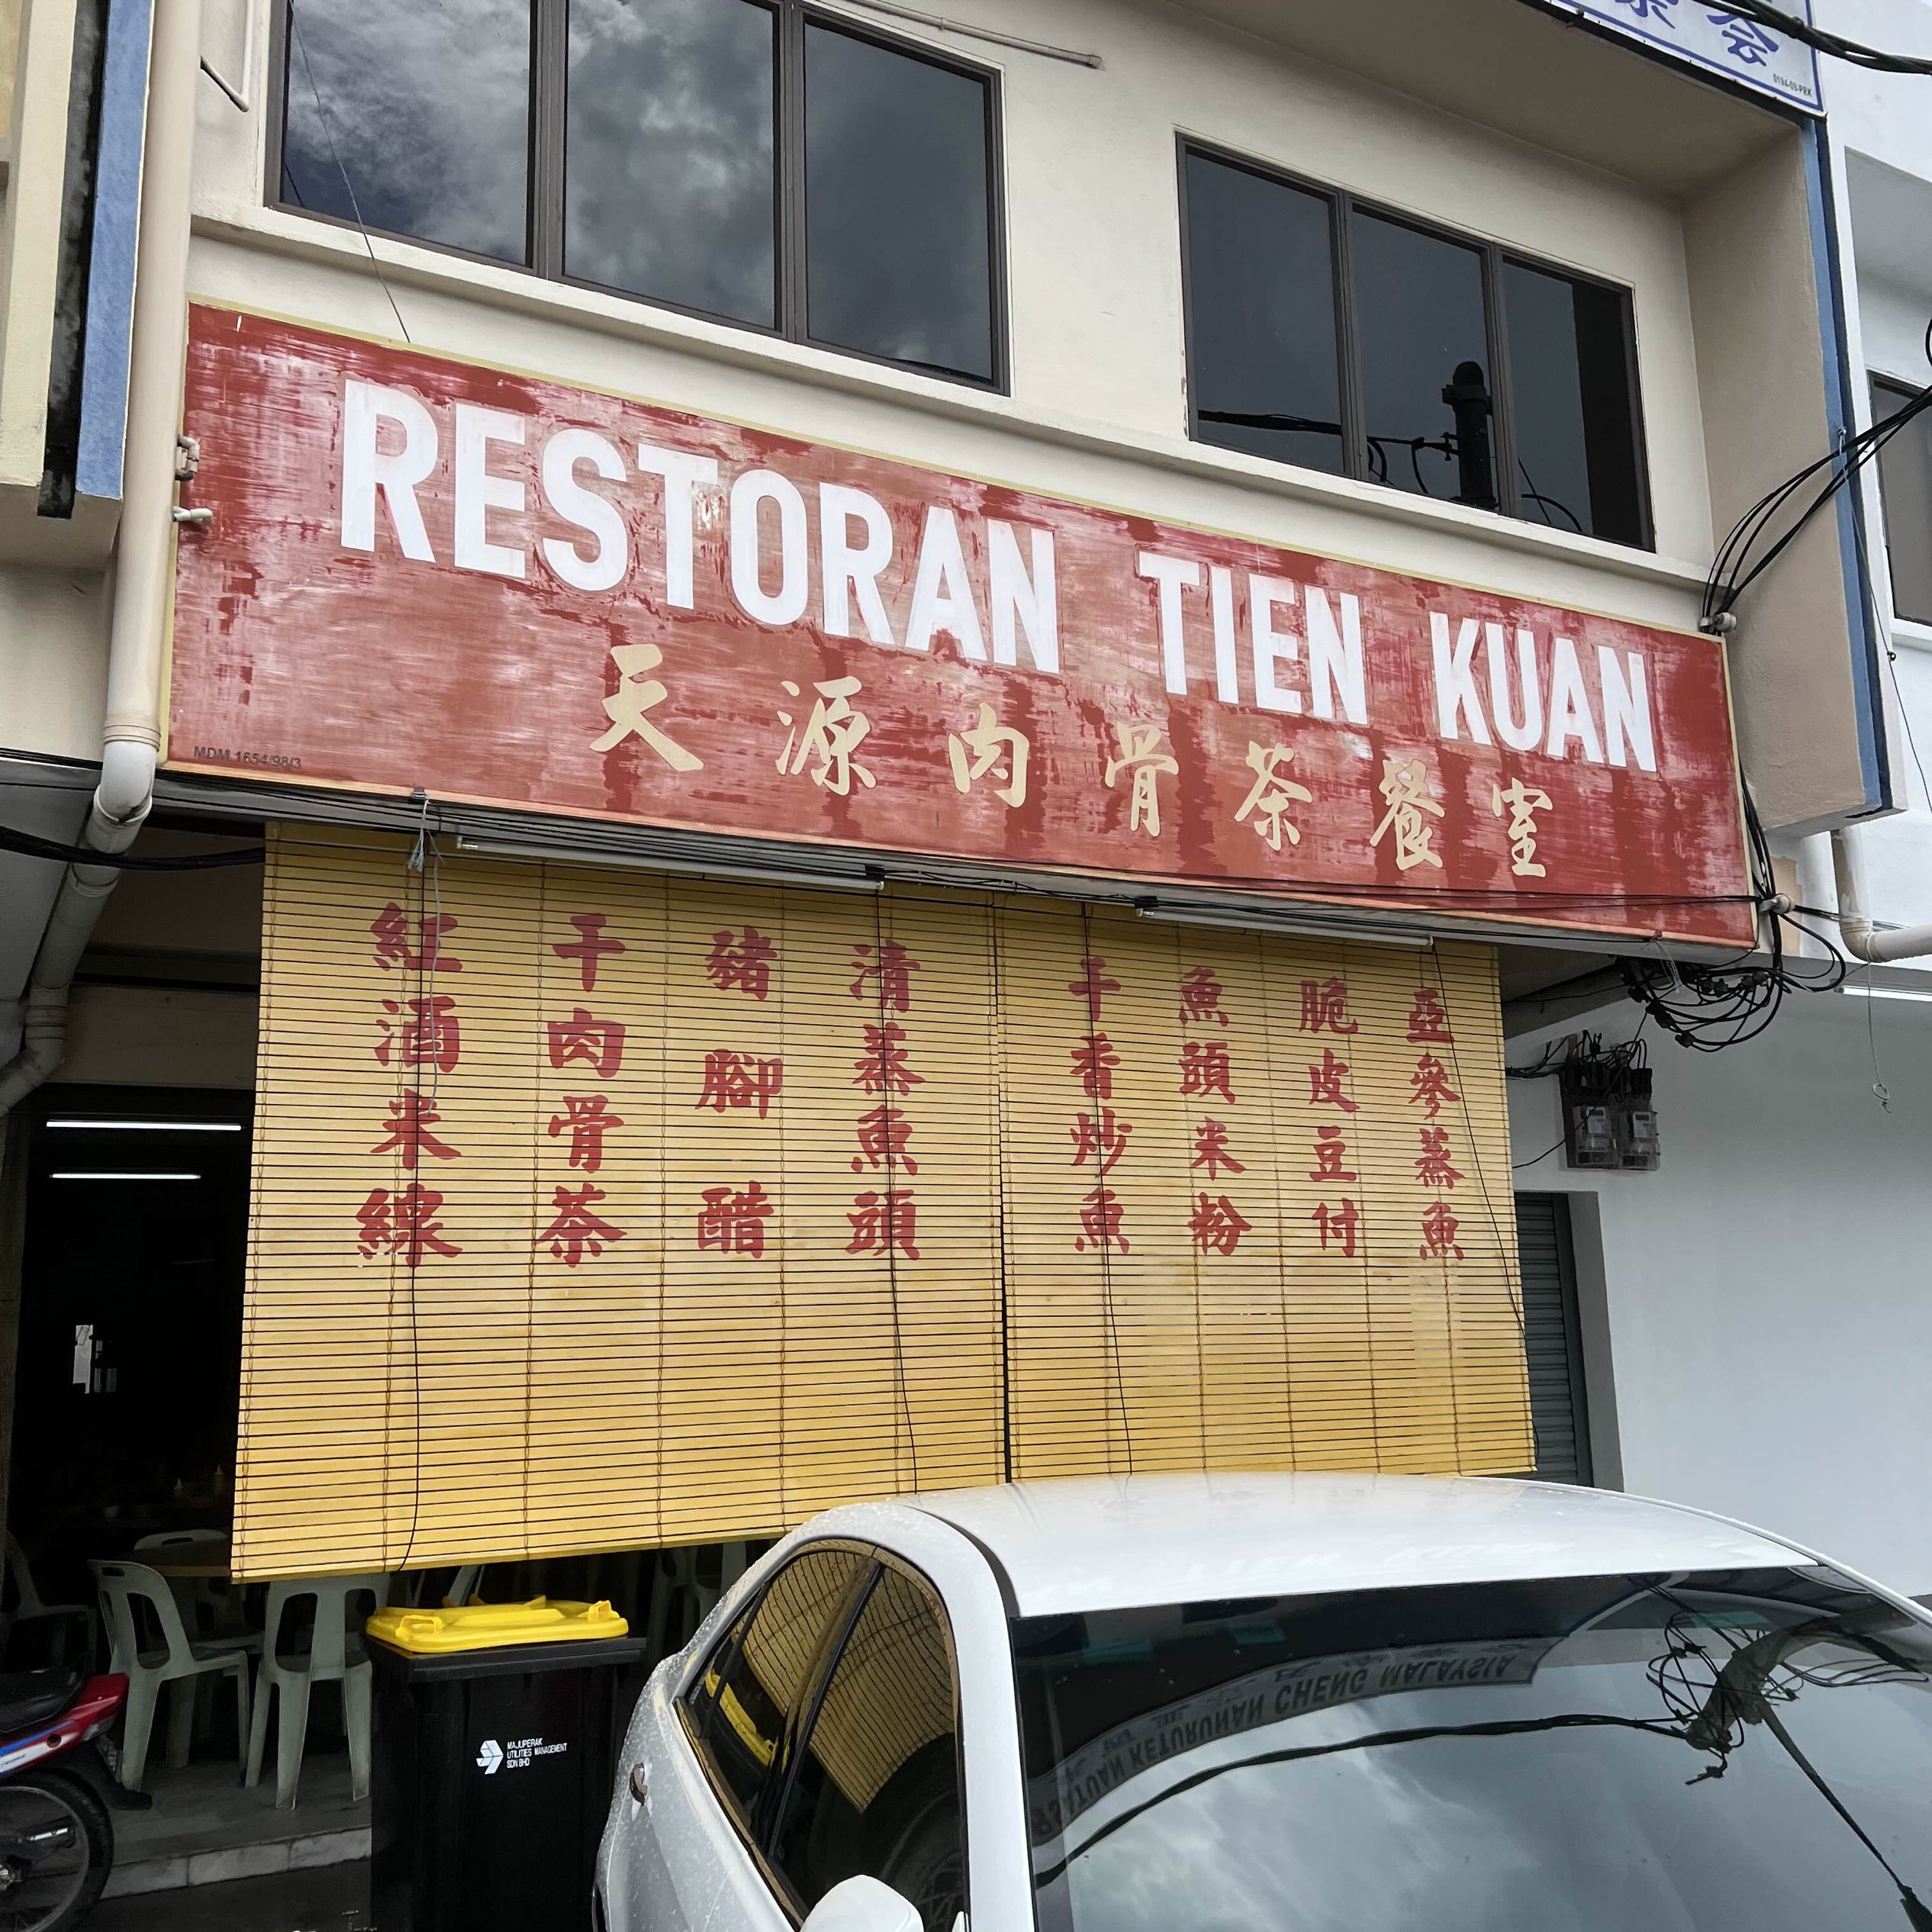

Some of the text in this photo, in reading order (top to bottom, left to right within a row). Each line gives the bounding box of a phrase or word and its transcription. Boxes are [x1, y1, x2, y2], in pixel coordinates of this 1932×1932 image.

[340, 378, 1658, 772] RESTORAN TIEN KUAN
[194, 745, 230, 762] MDM
[588, 642, 1554, 878] 天源肉骨茶餐室
[1177, 965, 1253, 1257] 魚頭米粉
[507, 1737, 543, 1750] MAJUPERAK
[507, 1742, 568, 1760] UTILITIES MANAGEMENT
[506, 1758, 530, 1769] SDN BHD
